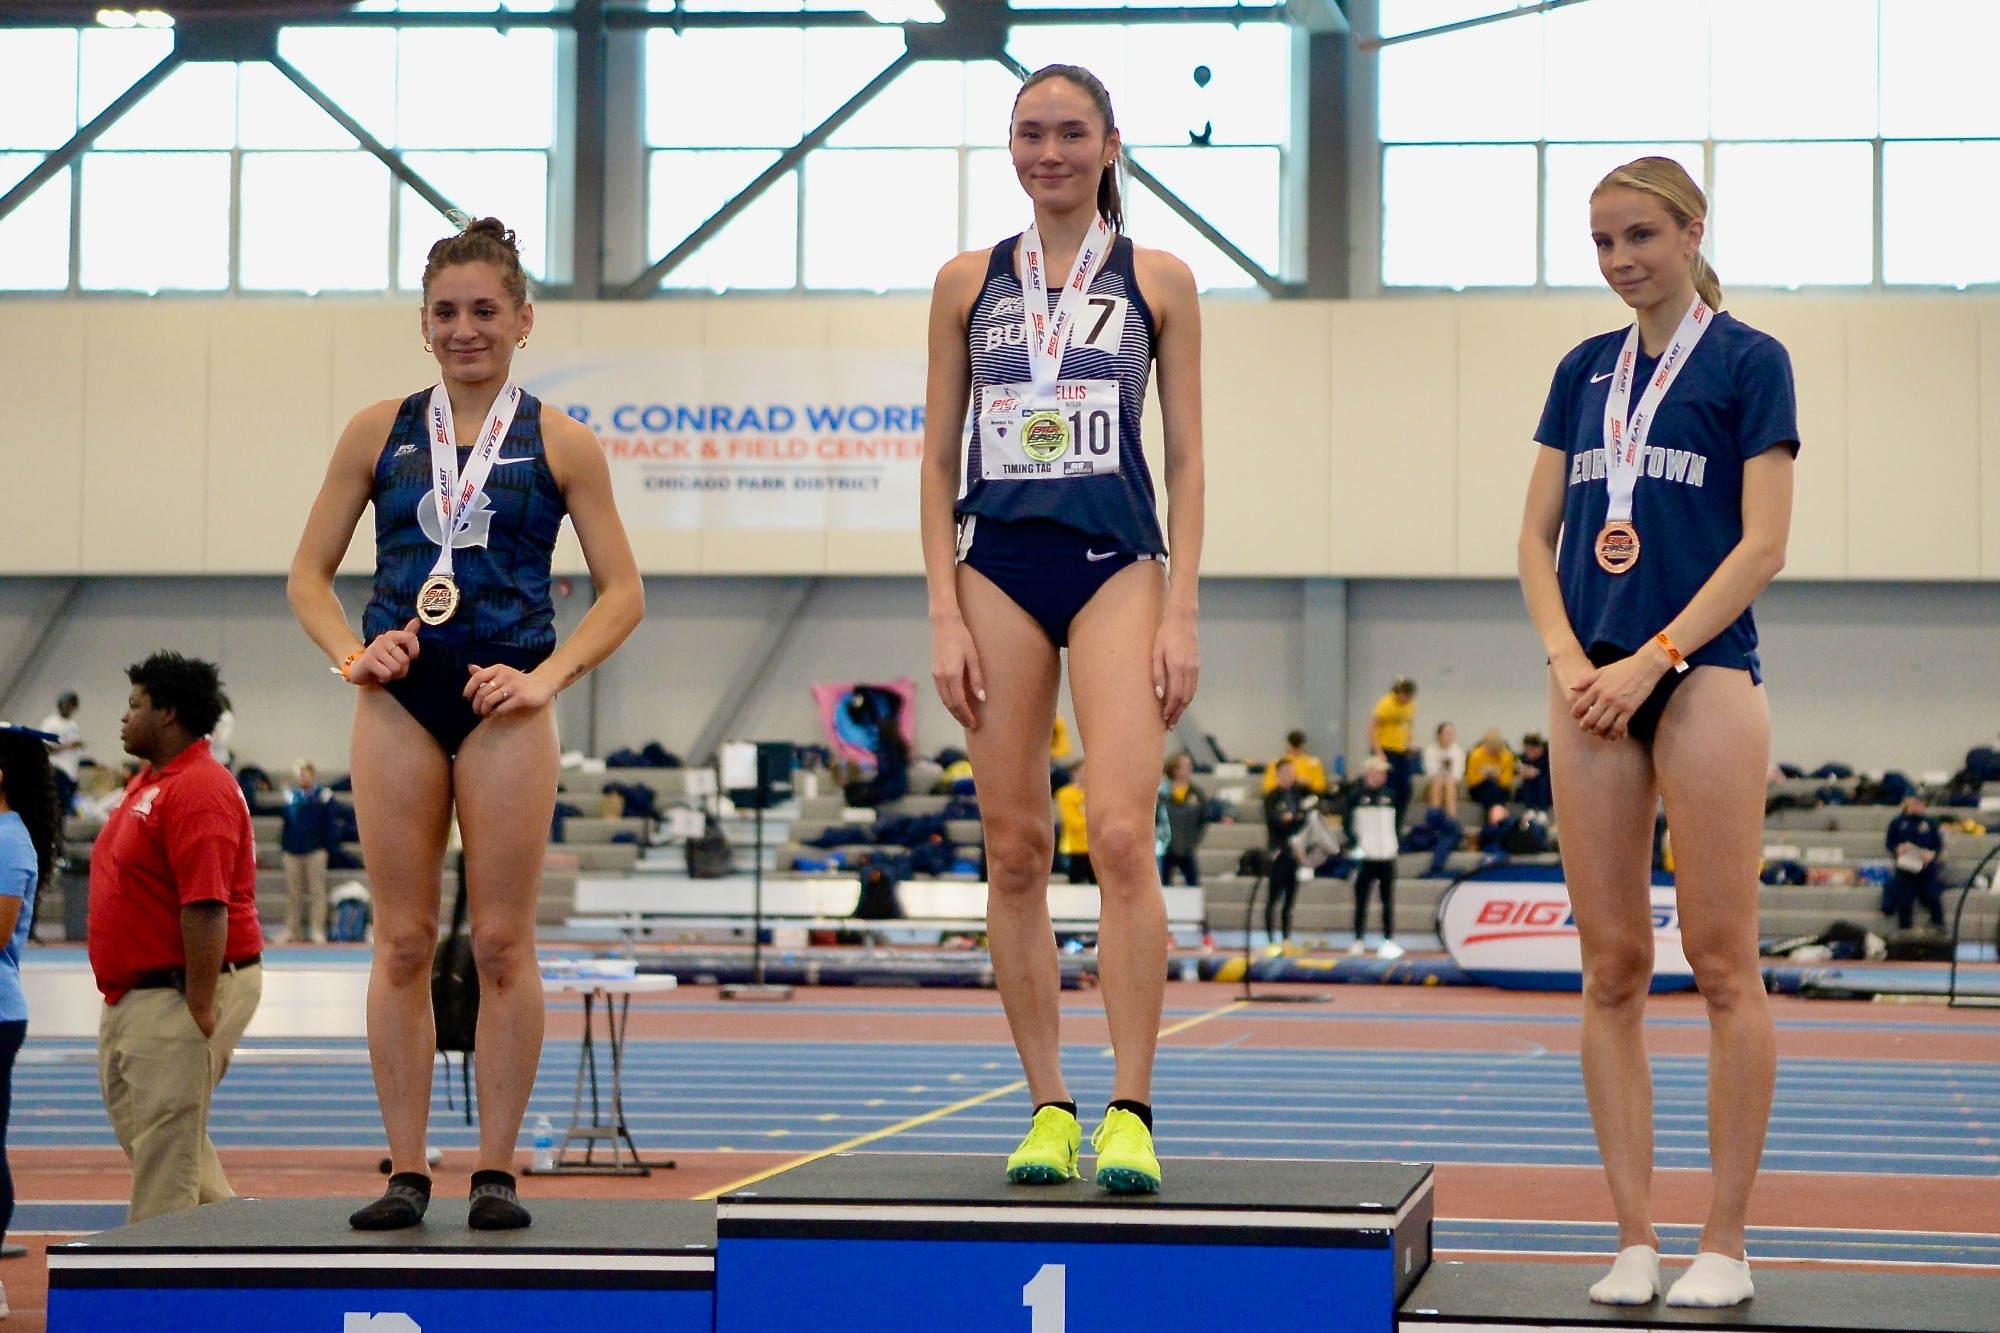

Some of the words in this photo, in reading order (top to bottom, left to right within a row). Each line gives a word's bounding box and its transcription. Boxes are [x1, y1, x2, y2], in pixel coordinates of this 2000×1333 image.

[1030, 251, 1038, 267] BIG
[1072, 272, 1083, 289] BIG
[1079, 248, 1093, 274] EAST
[1031, 266, 1041, 291] EAST
[1036, 314, 1044, 331] BIG
[1047, 336, 1057, 356] BIG
[1052, 310, 1066, 337] EAST
[1085, 298, 1117, 345] 7
[1655, 369, 1667, 387] BIG
[1664, 342, 1681, 371] EAST
[991, 398, 1015, 408] BIG
[434, 406, 443, 429] EAST
[493, 420, 503, 437] BIG
[567, 405, 603, 432] R.
[613, 405, 796, 433] CONRAD
[806, 405, 926, 433] WORR
[1032, 425, 1058, 434] BIG
[436, 428, 445, 444] BIG
[1028, 433, 1064, 444] EAST
[1068, 410, 1111, 456] 10
[1625, 442, 1635, 464] BIG
[1631, 412, 1643, 443] EAST
[483, 434, 497, 461] EAST
[600, 437, 692, 460] TRACK
[702, 437, 720, 460] &
[729, 438, 807, 460] FIELD
[1002, 464, 1034, 474] TIMING
[1036, 463, 1052, 473] TAG
[1569, 445, 1707, 488] EORTOWN
[440, 467, 448, 497] EAST
[463, 483, 475, 505] BIG
[644, 476, 730, 491] CHICAGO
[738, 476, 786, 491] PARK
[795, 476, 881, 491] DISTRICT
[417, 488, 497, 549] G
[1475, 900, 1568, 926] BIG
[1022, 1263, 1066, 1333] 1
